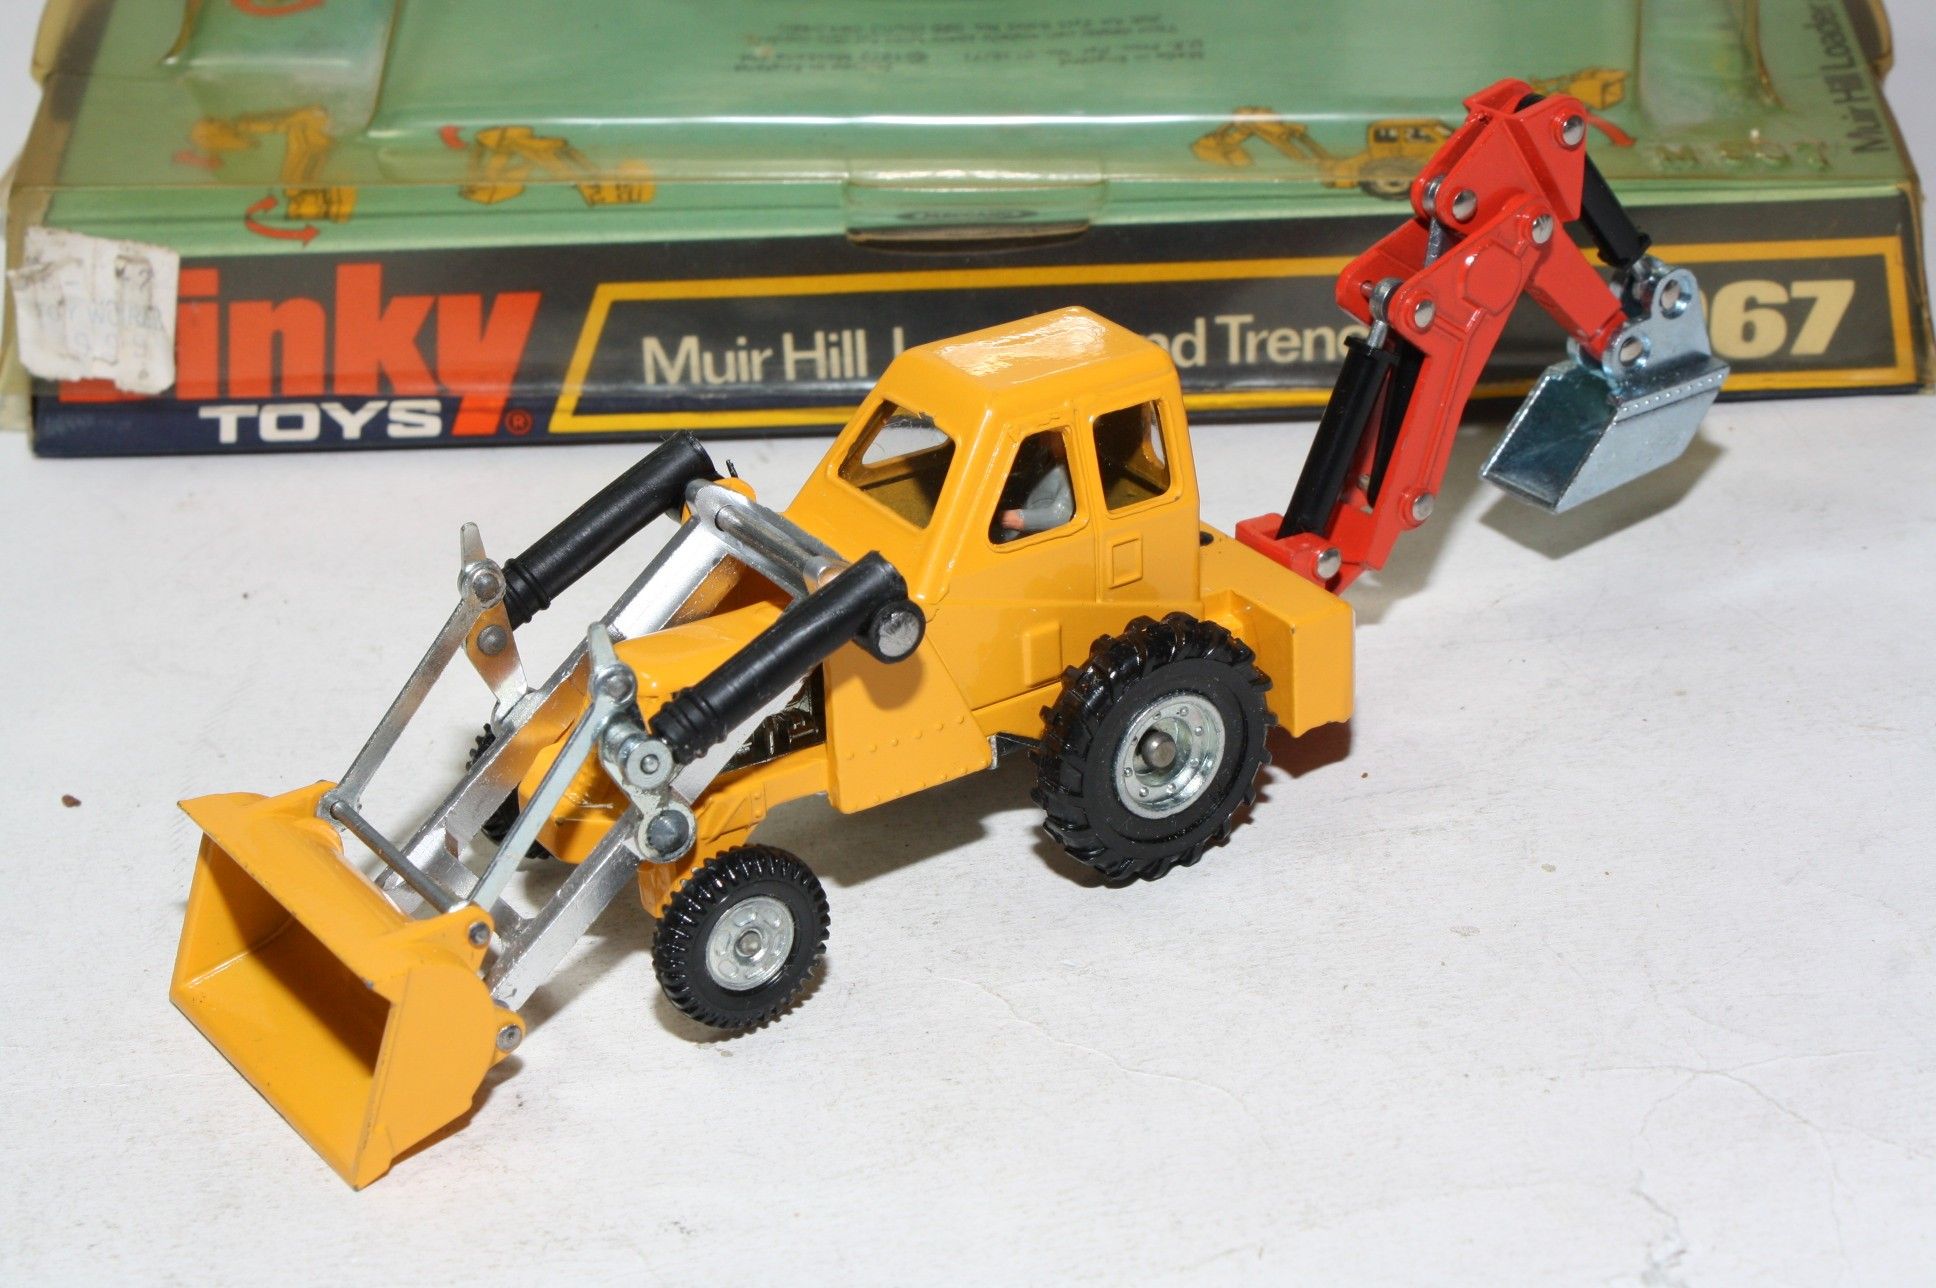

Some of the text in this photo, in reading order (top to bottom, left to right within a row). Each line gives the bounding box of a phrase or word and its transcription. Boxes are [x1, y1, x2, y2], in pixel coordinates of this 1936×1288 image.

[59, 262, 541, 436] inky
[1701, 279, 1855, 360] 67
[641, 334, 774, 385] Muir
[782, 328, 868, 382] Hill
[198, 398, 443, 444] TOYS
